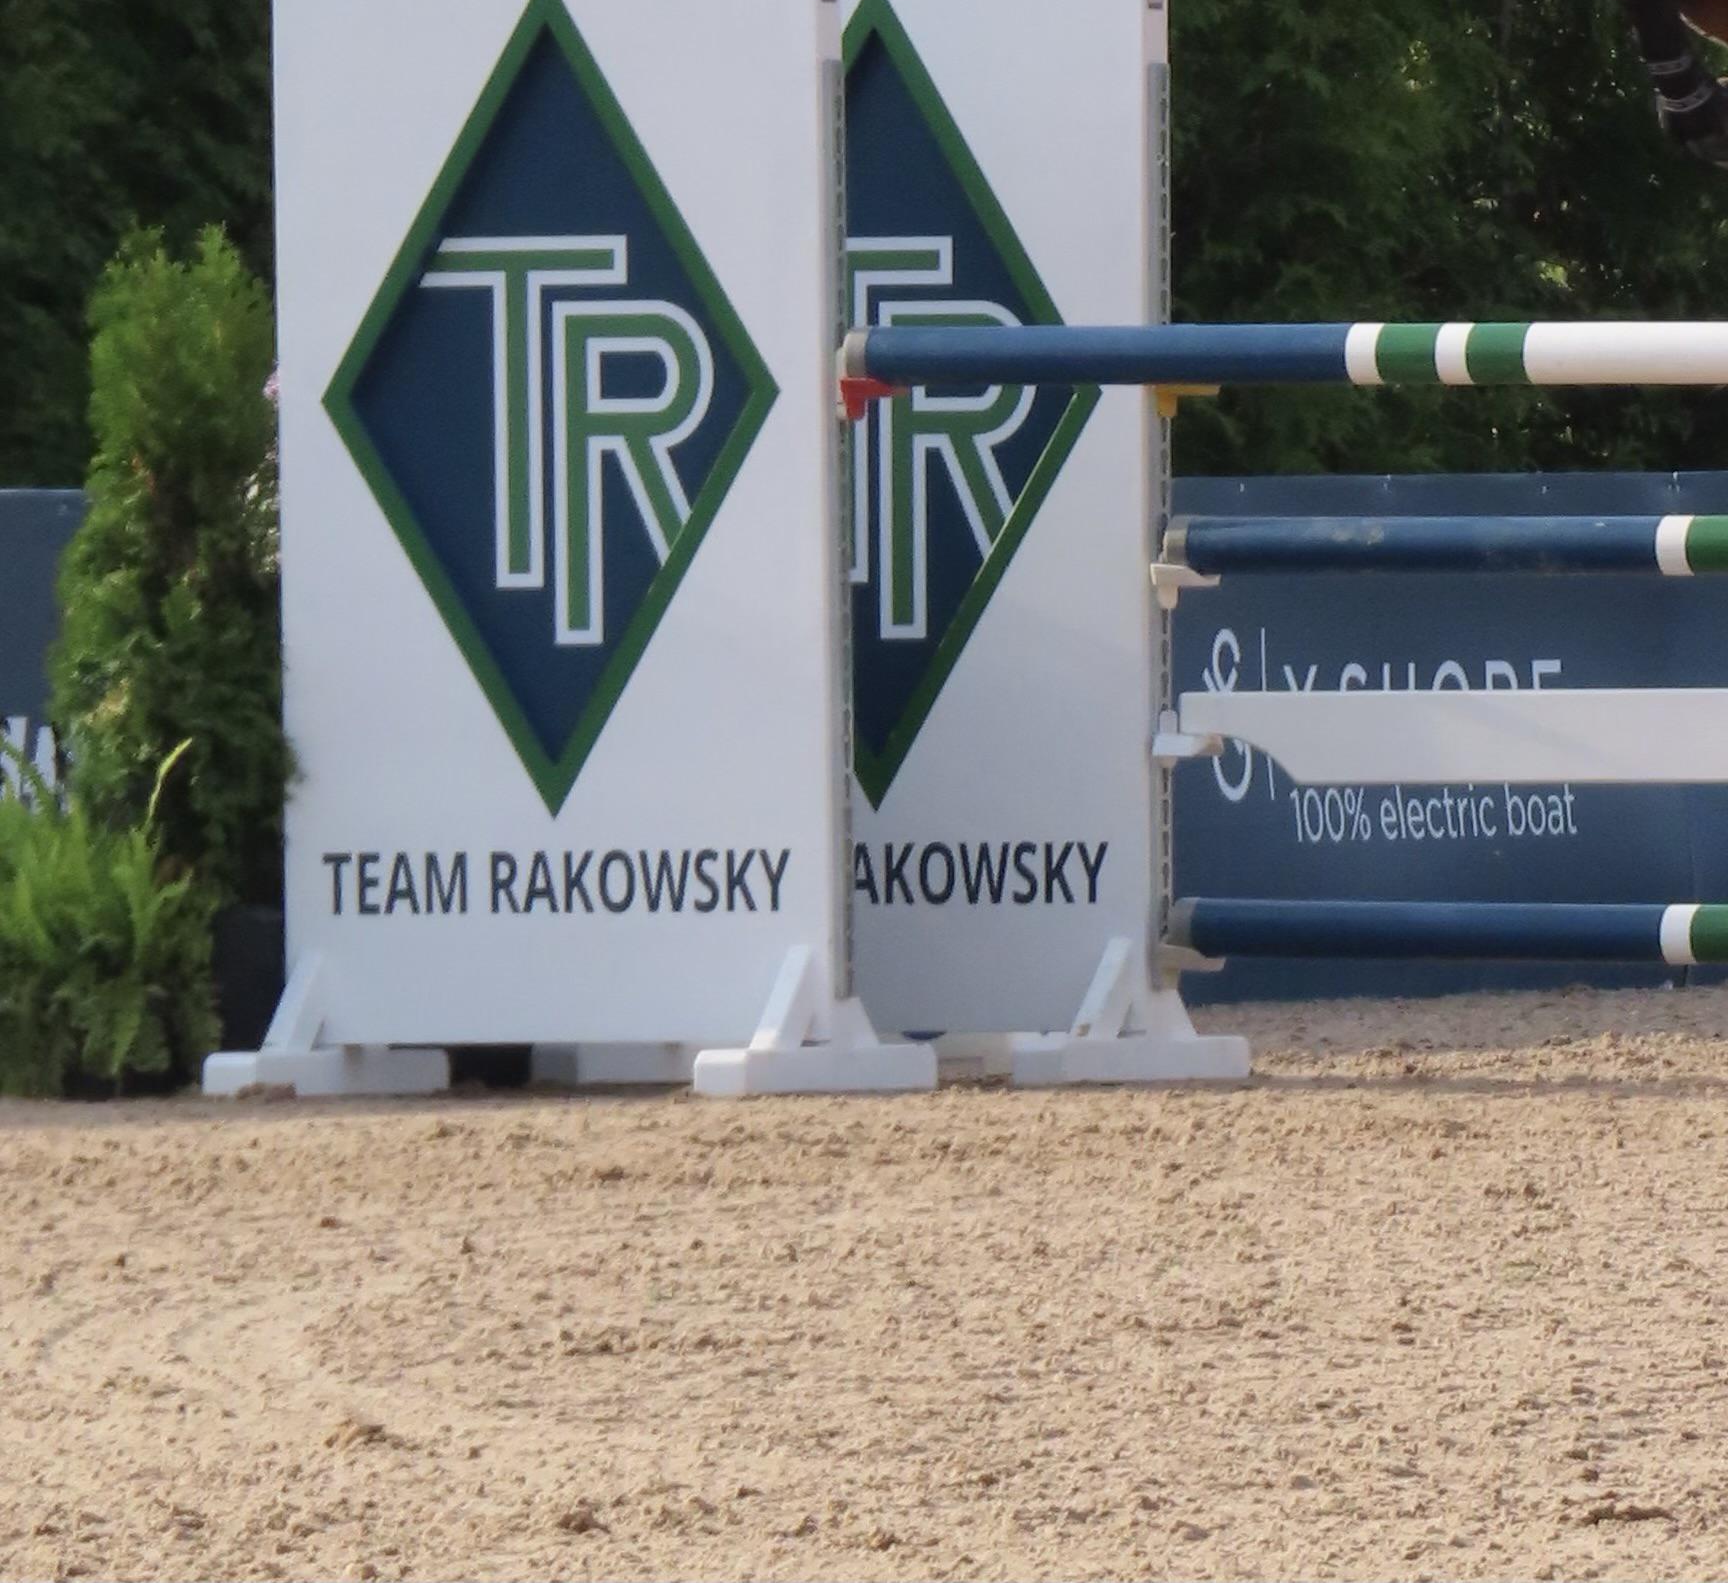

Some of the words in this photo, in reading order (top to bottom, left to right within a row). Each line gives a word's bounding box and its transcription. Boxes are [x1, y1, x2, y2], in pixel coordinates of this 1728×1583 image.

[419, 234, 714, 645] TR
[1289, 787, 1371, 843] 100%
[1379, 783, 1497, 840] electric
[1504, 782, 1578, 837] boat
[323, 852, 468, 915] TEAM
[490, 848, 791, 914] RAKOWSKY
